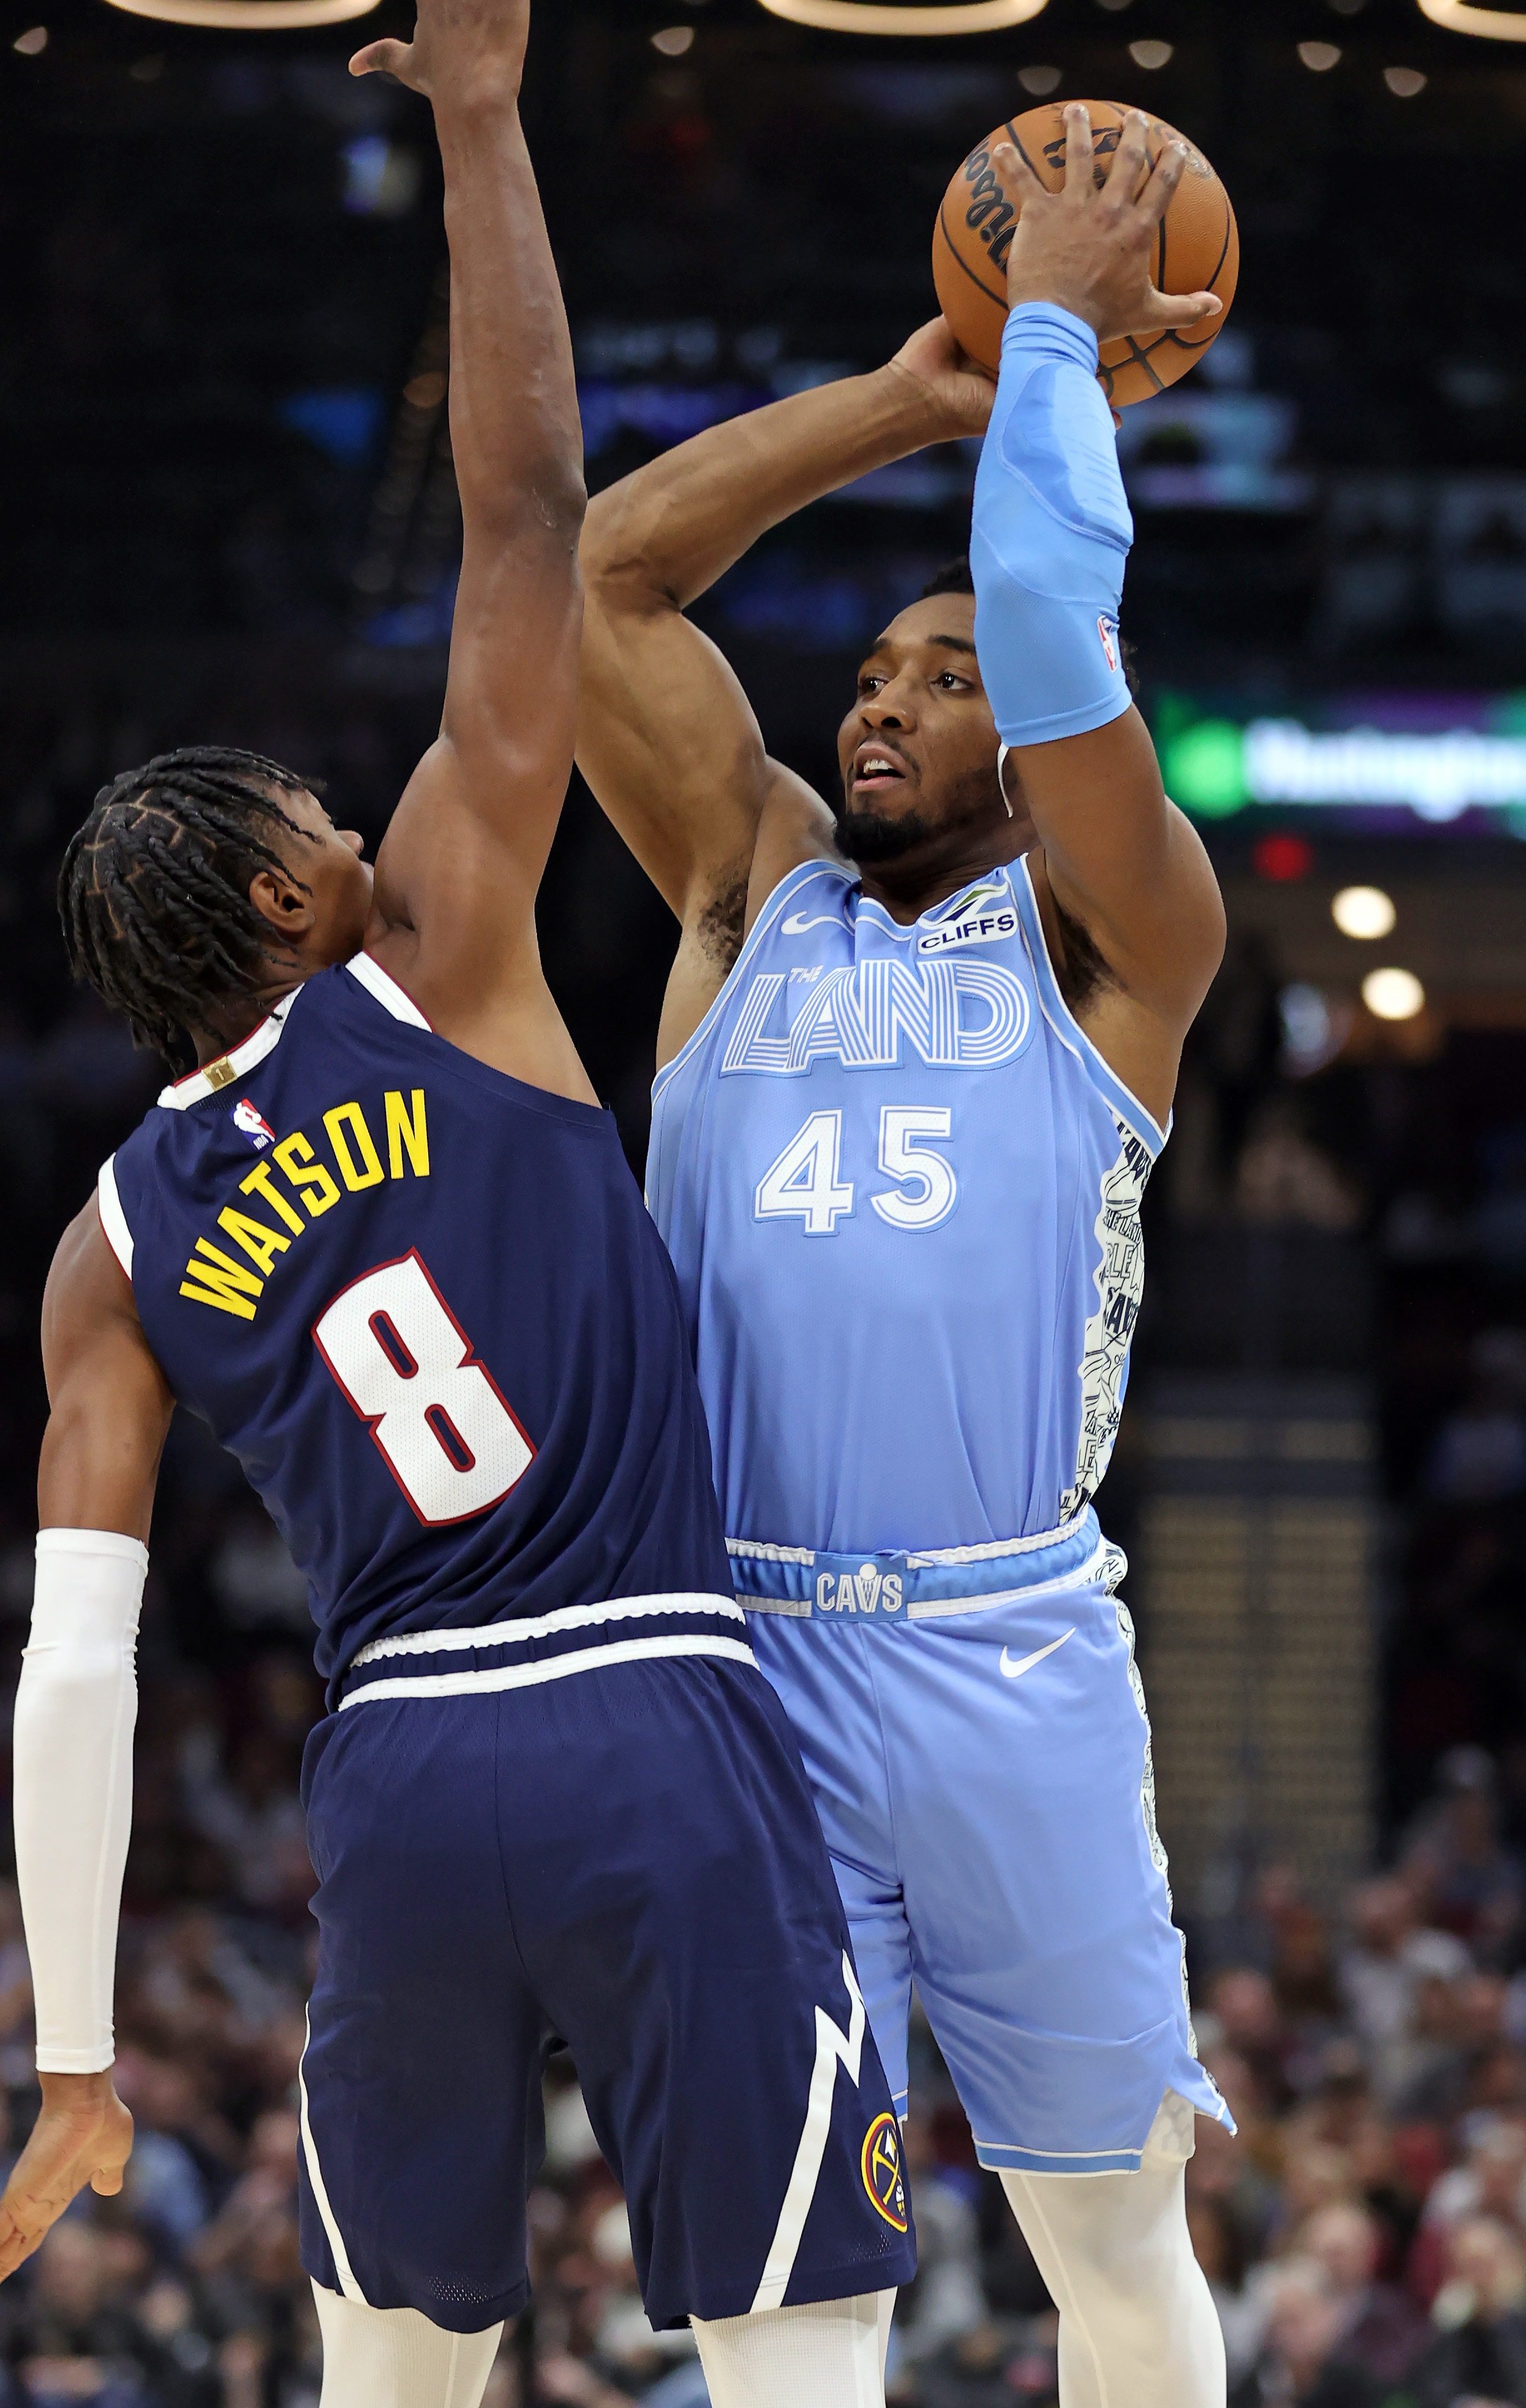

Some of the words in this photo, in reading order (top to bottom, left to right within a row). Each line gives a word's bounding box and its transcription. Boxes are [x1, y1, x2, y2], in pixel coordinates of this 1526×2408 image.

[921, 913, 1015, 949] CLIFFS
[720, 958, 1032, 1073] LAND
[787, 965, 823, 984] THE
[253, 1135, 269, 1150] NBA
[754, 1104, 957, 1233] 45
[179, 1089, 430, 1322] WATSON
[311, 1247, 537, 1528] 8
[817, 1563, 903, 1613] CAVS
